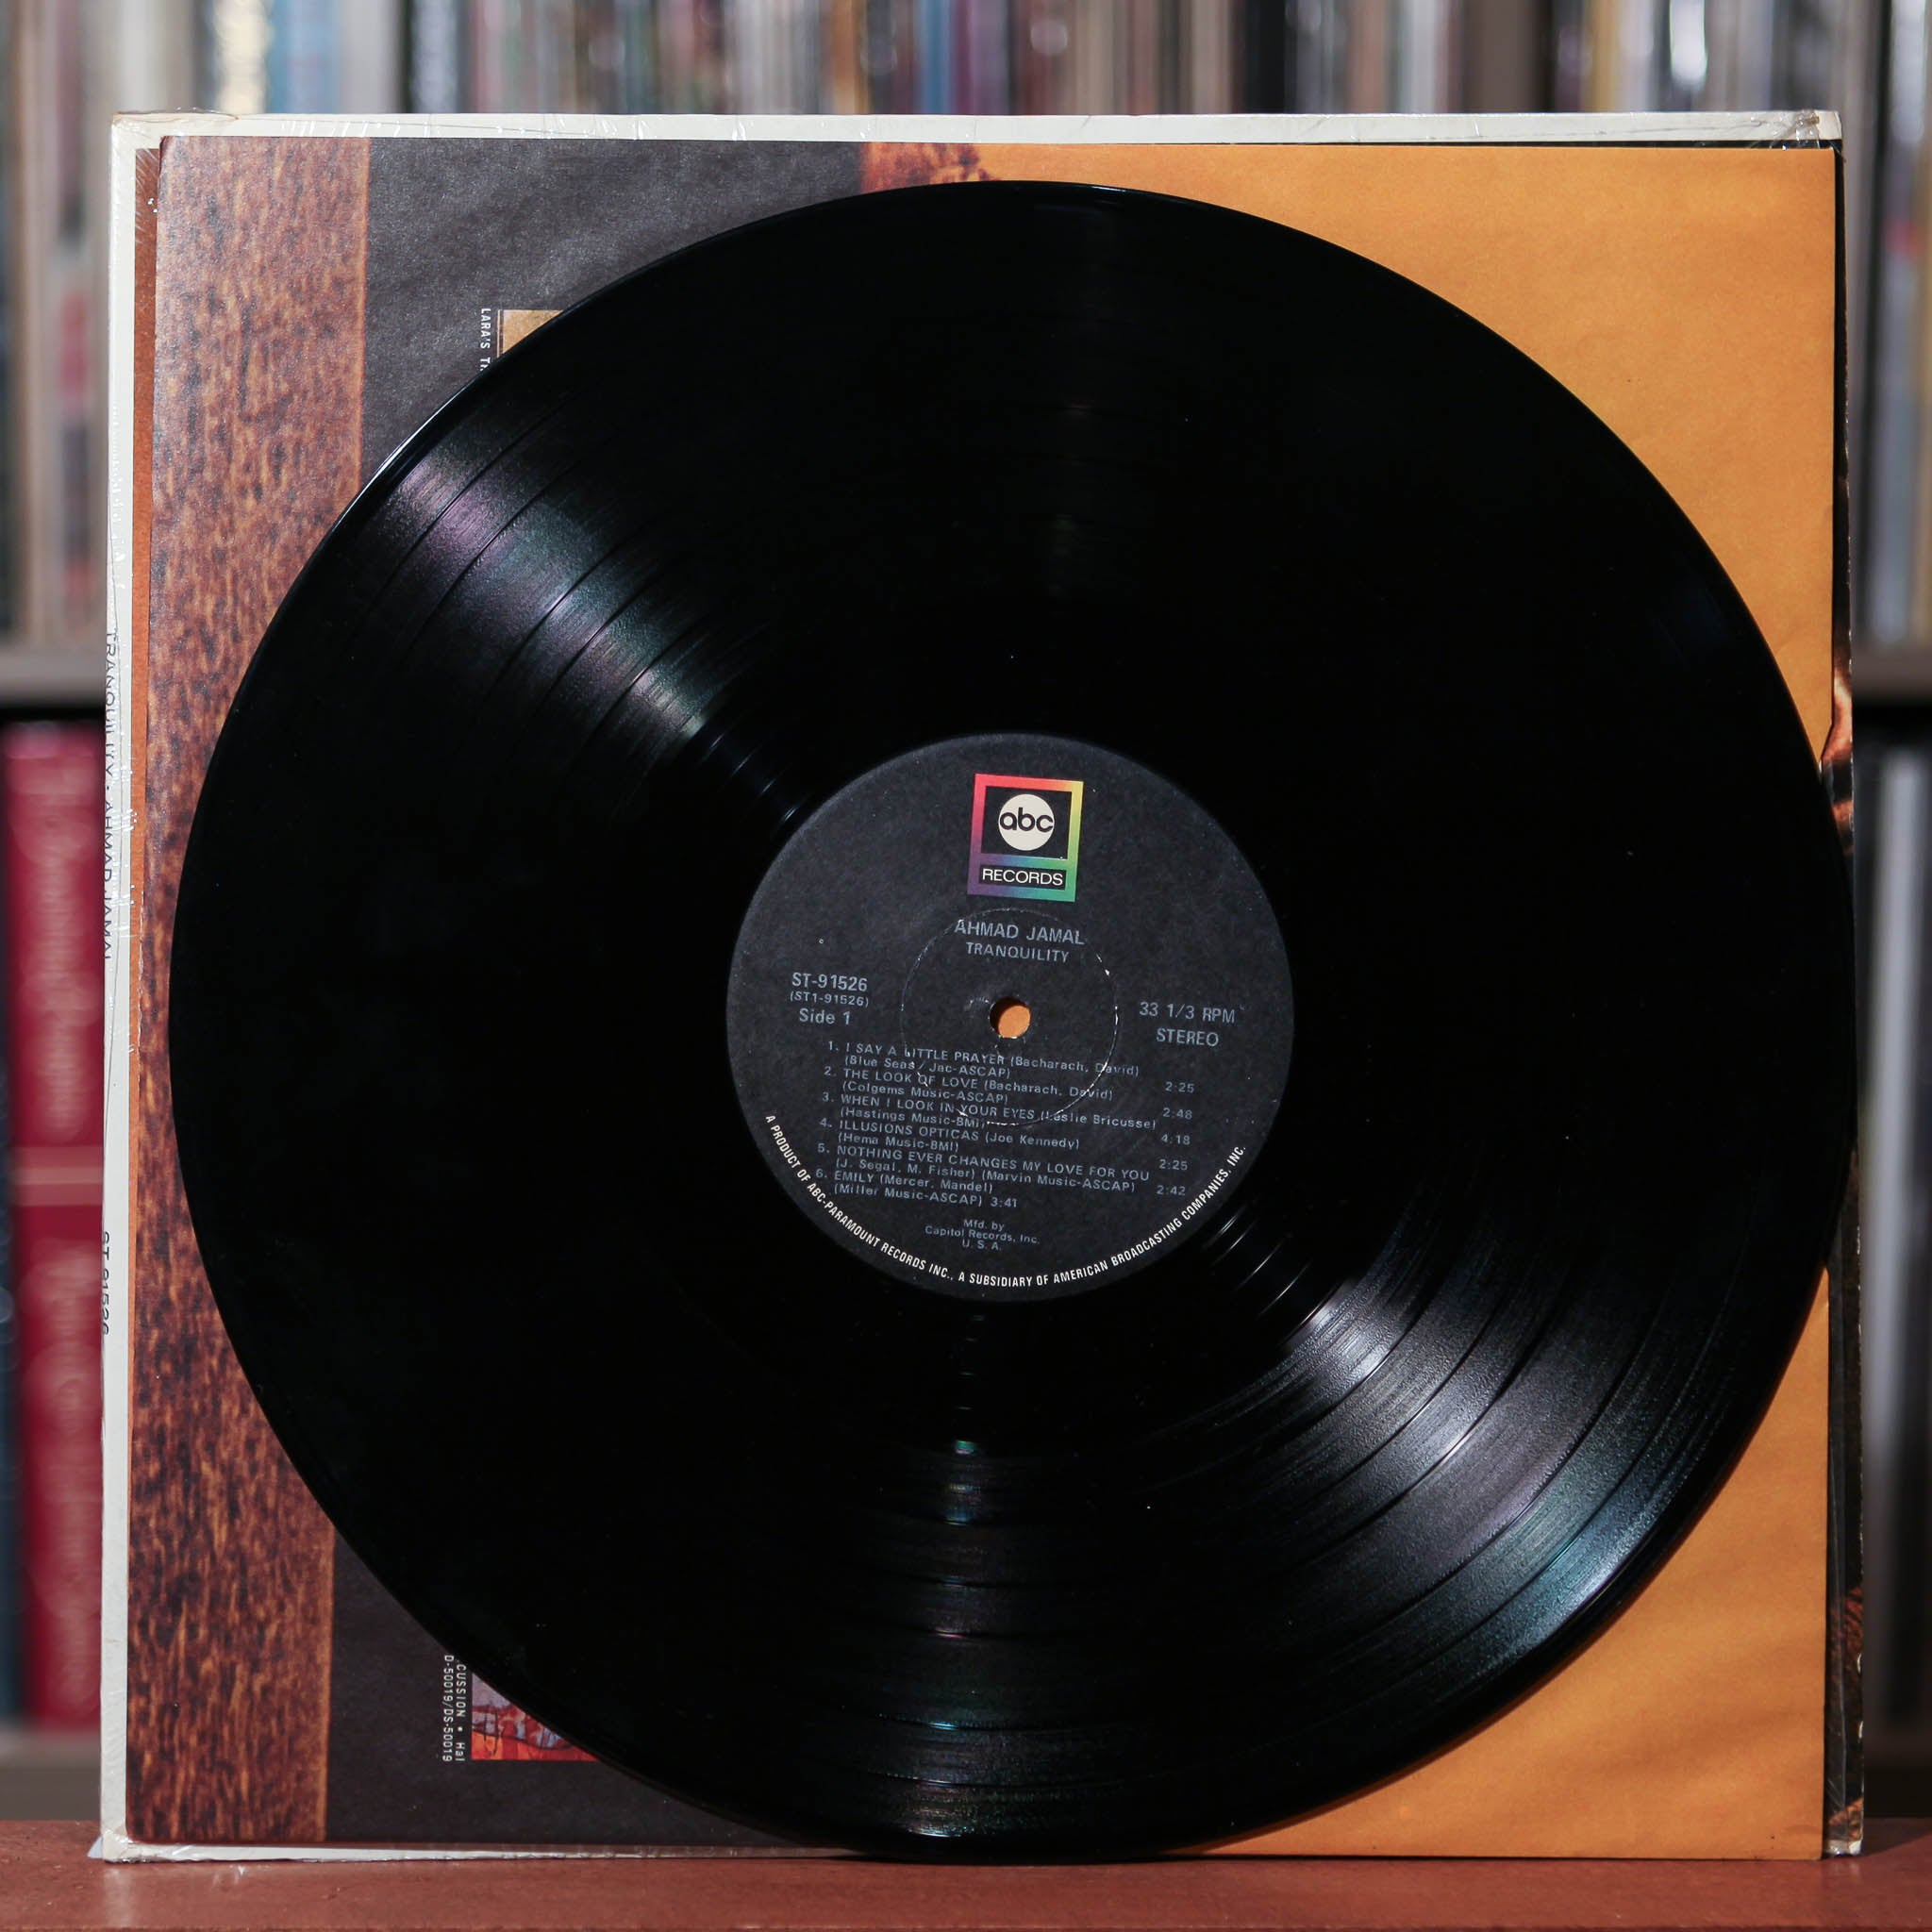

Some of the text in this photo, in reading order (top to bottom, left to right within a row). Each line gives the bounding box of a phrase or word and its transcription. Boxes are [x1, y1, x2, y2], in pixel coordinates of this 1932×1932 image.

[480, 308, 491, 349] LARA'S
[1000, 808, 1054, 832] abc
[982, 869, 1063, 886] RECORDS
[954, 920, 1085, 944] AHMAD JAMAL
[966, 942, 1069, 962] TRANQUILITY
[791, 972, 868, 991] ST-91526
[790, 991, 869, 1008] (ST1-91526)
[799, 1008, 850, 1024] Side 1
[1140, 1002, 1235, 1024] 33 1/3 RPM
[1157, 1028, 1219, 1046] STEREO
[828, 1041, 839, 1051] 1.
[846, 1042, 850, 1052] I
[856, 1044, 883, 1055] SAY
[888, 1046, 897, 1056] A
[904, 1047, 948, 1060] LITTLE
[955, 1051, 1005, 1065] PRAYER
[1095, 1062, 1139, 1076] David)
[845, 1055, 877, 1067] (Blue
[824, 1066, 837, 1076] 2.
[843, 1068, 869, 1079] THE
[875, 1072, 912, 1083] LOOK
[918, 1074, 936, 1085] OF
[942, 1076, 978, 1089] LOVE
[1070, 1087, 1113, 1101] David)
[842, 1081, 1008, 1103] (Colgems Music-ASCAP)
[1165, 1082, 1194, 1093] 2:25
[823, 1092, 834, 1103] 3.
[841, 1094, 879, 1106] WHEN
[887, 1097, 890, 1107] I
[897, 1100, 934, 1110] LOOK
[940, 1104, 955, 1113] IN
[960, 1105, 997, 1116] YOUR
[1003, 1108, 1035, 1120] EYES
[1093, 1115, 1156, 1129] Bricusse)
[841, 1107, 906, 1122] (Hastings
[1163, 1108, 1192, 1119] 2:48
[820, 1118, 1079, 1150] 4. ILLUSIONS OPTICAS (Joe Kennedy)
[839, 1132, 958, 1152] (Hema Music-BMI)
[1161, 1134, 1191, 1145] 4:18
[818, 1143, 1149, 1181] 5. NOTHING EVER CHANGES MY LOVE FOR YOU
[1159, 1159, 1188, 1170] 2:25
[815, 1169, 827, 1178] 6.
[835, 1171, 878, 1183] EMILY
[941, 1180, 992, 1193] Mandel)
[837, 1158, 853, 1169] (J.
[908, 1164, 922, 1174] M.
[928, 1166, 974, 1179] Fisher)
[982, 1170, 1031, 1183] (Marvin
[1038, 1174, 1135, 1191] Music-ASCAP)
[834, 1184, 1018, 1208] (Miller Music-ASCAP) 3:41
[1157, 1185, 1186, 1196] 2:42
[766, 1115, 1246, 1288] A PRODUCT OF ABC-PARAMOUNT RECORDS INC., A SUBSIDIARY OF AMERICAN BROADCASTING COMPANIES, INC.
[924, 1225, 1040, 1244] Capitol Records, Inc.
[963, 1219, 1004, 1232] Mfd. by
[442, 1655, 455, 1762] D-50019/DS-50019
[455, 1660, 467, 1762] CUSSION Hal
